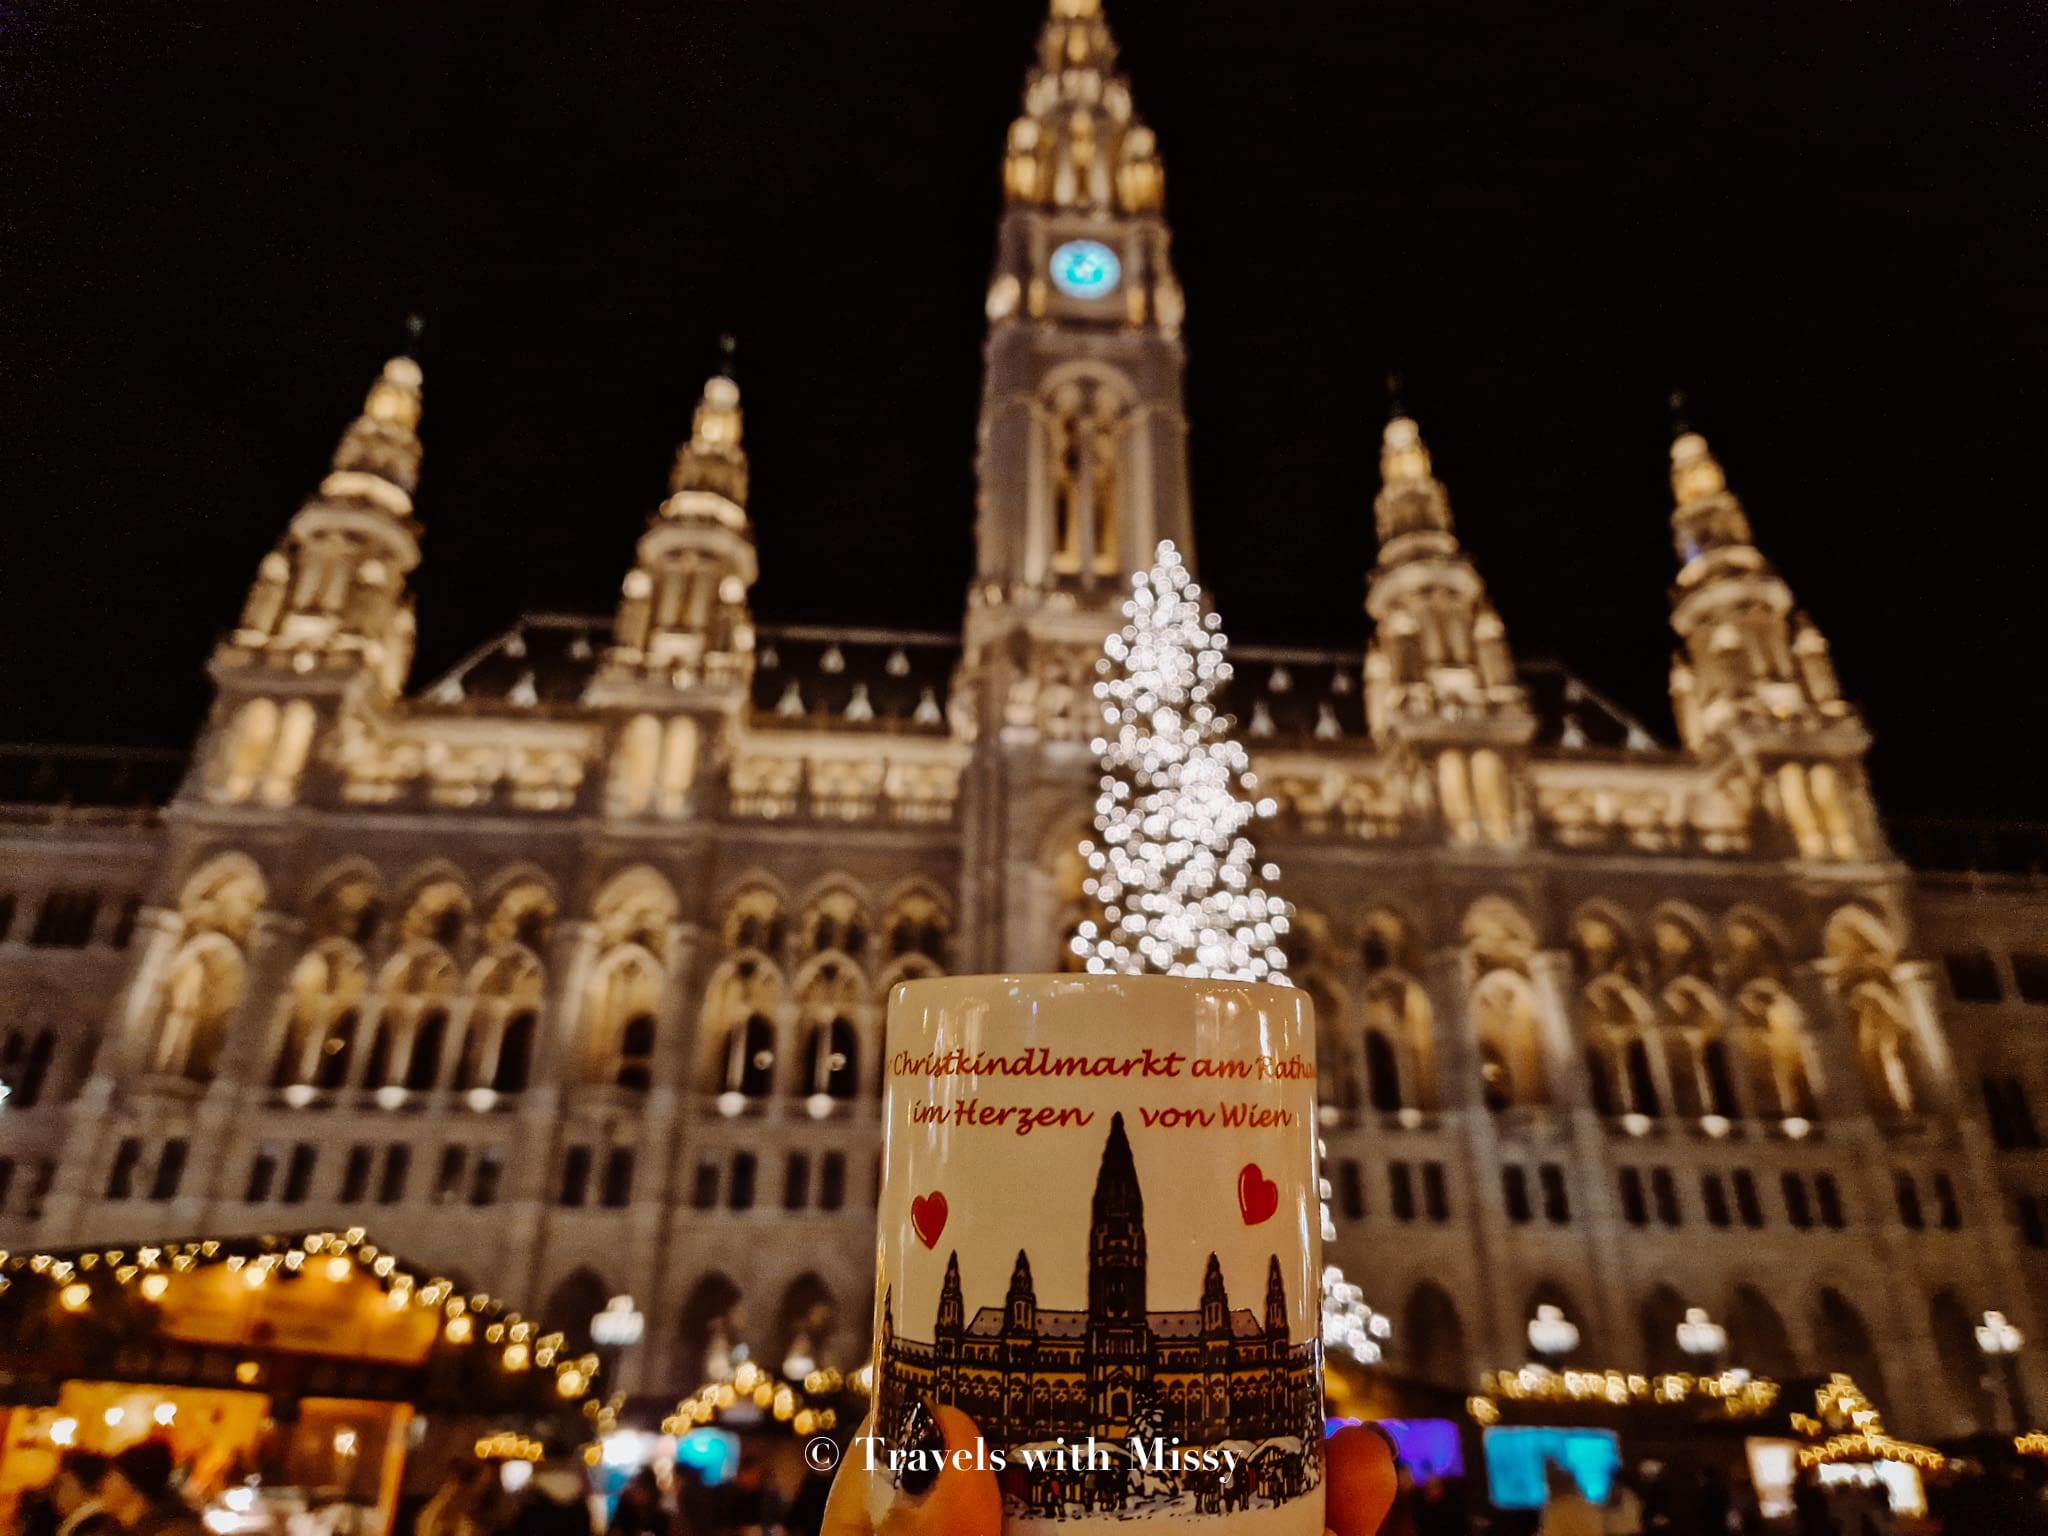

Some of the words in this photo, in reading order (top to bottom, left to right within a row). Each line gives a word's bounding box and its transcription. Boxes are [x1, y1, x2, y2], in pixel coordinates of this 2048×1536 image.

[894, 1048, 1186, 1078] Christkindlmarkt
[1191, 1058, 1252, 1078] am
[914, 1100, 950, 1123] im
[954, 1098, 1094, 1136] Herzen
[1139, 1107, 1215, 1127] von
[1220, 1101, 1292, 1127] Wien
